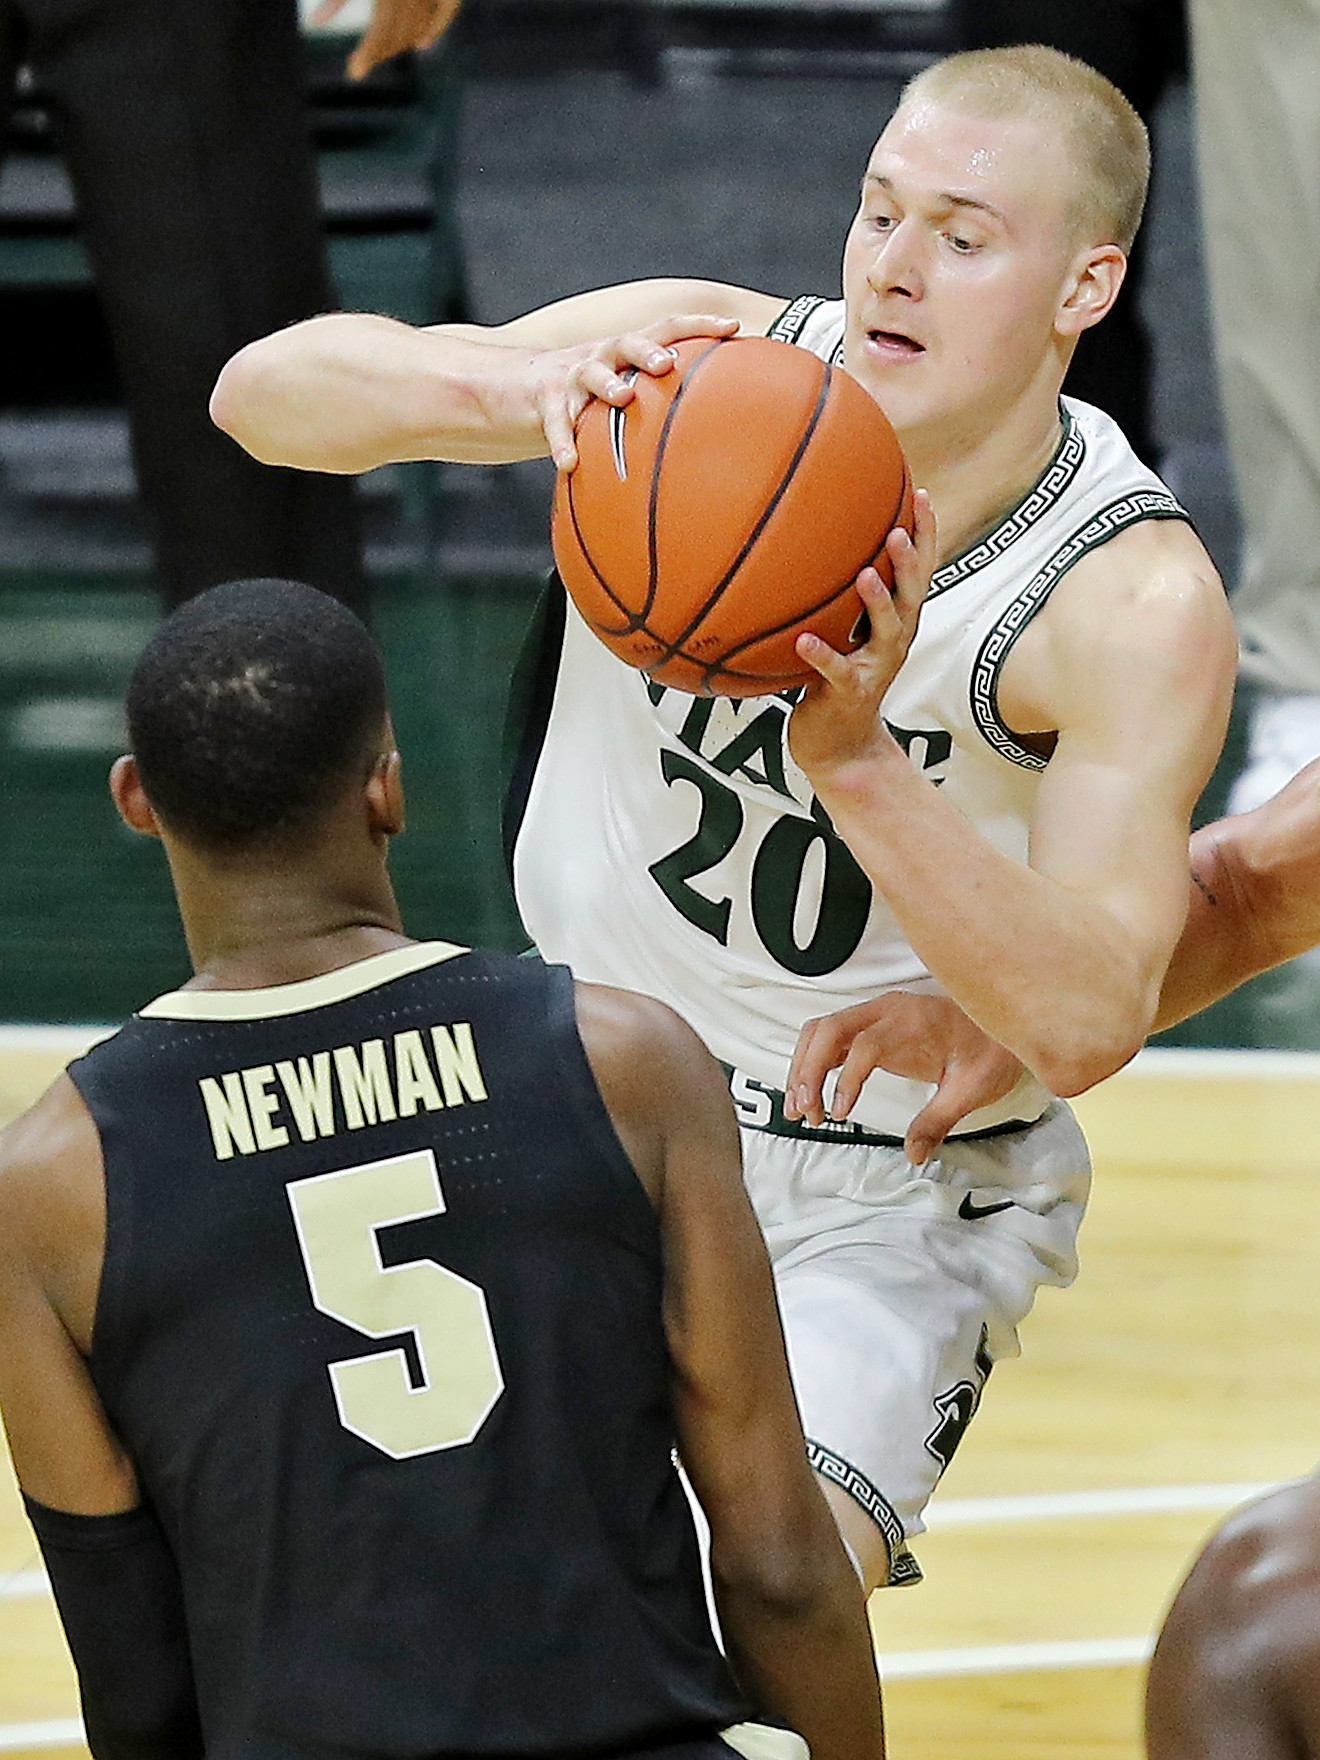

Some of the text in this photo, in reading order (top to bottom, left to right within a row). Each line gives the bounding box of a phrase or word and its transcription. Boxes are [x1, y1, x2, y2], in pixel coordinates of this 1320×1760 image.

[647, 747, 873, 978] 20
[199, 1020, 489, 1161] NEWMAN
[285, 1148, 506, 1461] 5
